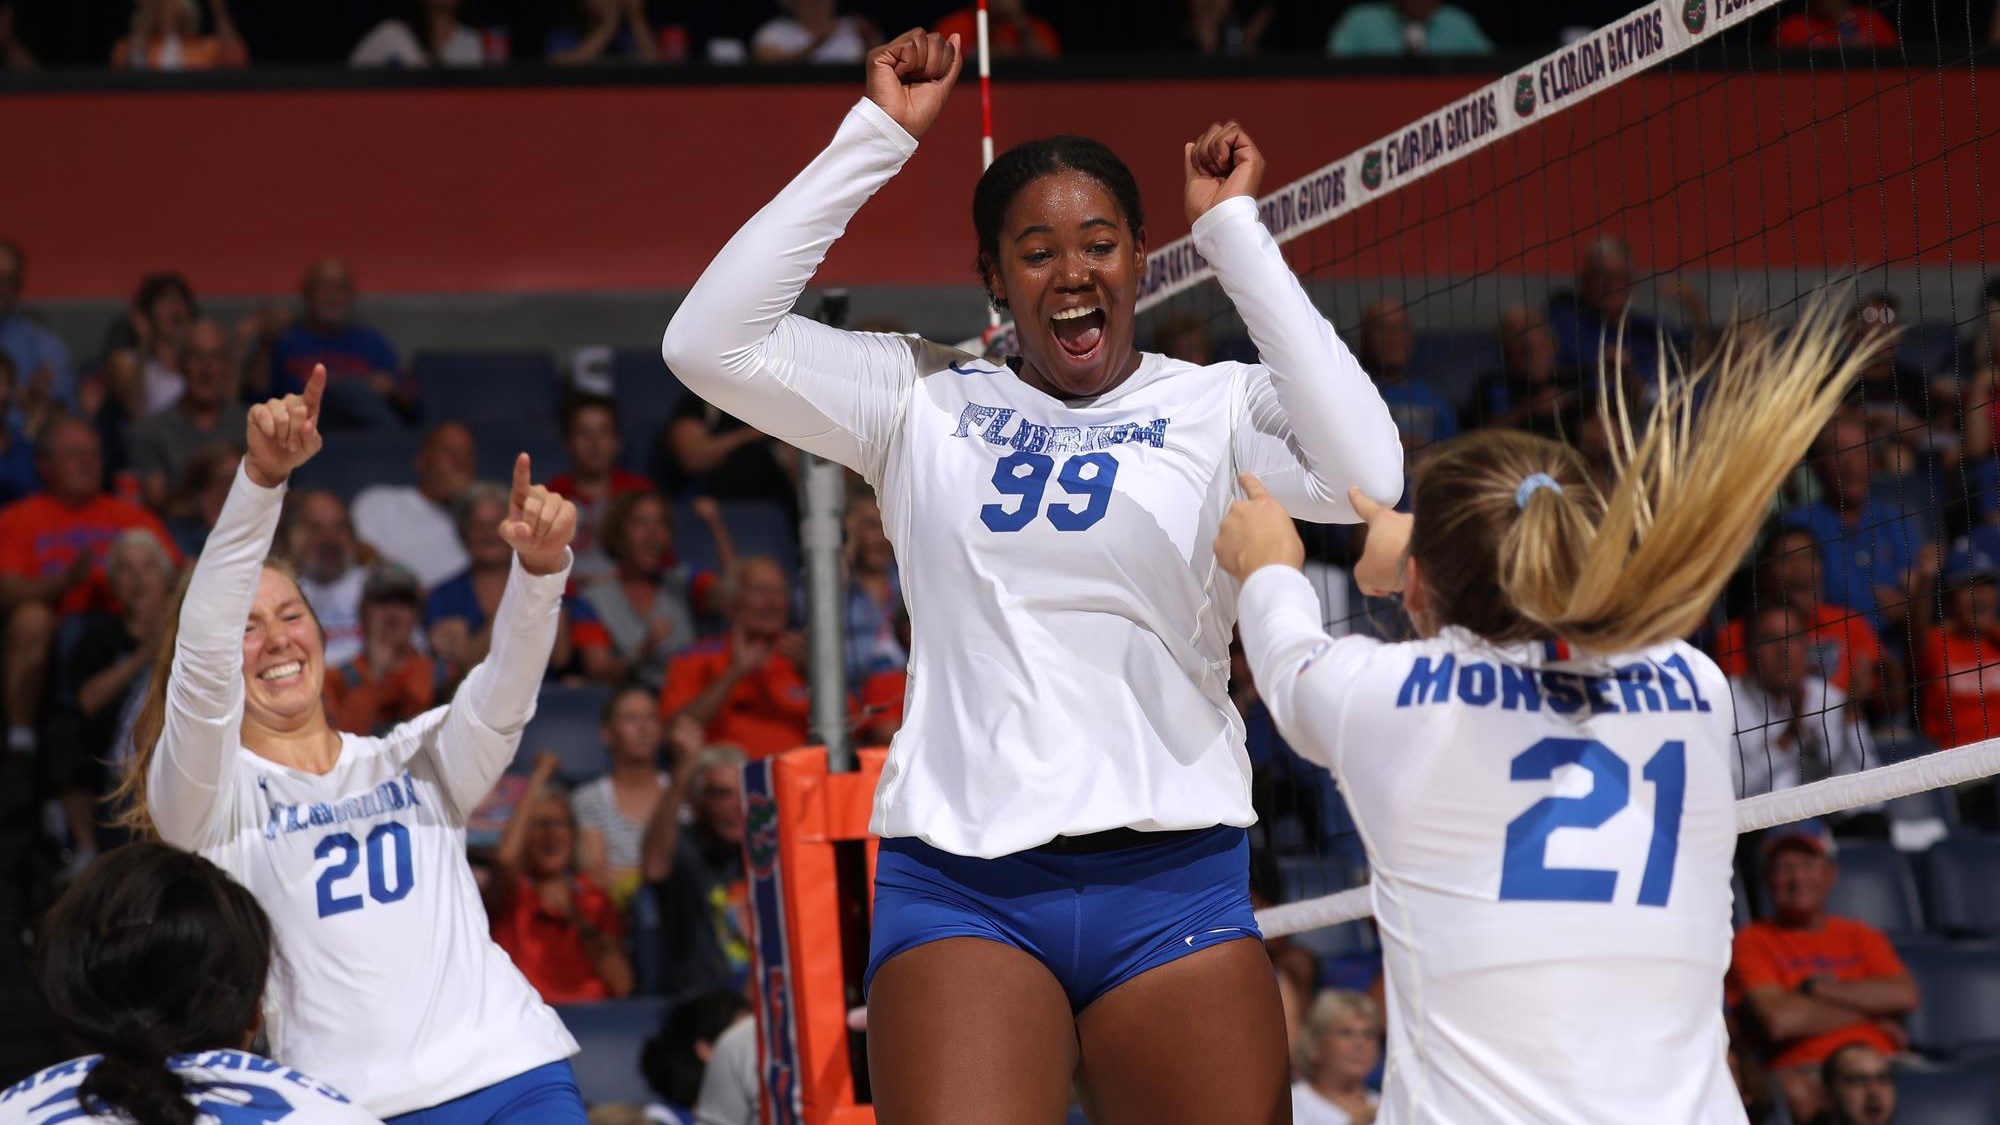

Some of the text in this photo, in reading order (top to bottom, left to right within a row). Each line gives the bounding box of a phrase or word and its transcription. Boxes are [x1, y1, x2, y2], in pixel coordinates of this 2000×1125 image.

[1539, 8, 1664, 104] FLORIDA GATORS
[1386, 117, 1444, 180] FLORDA
[950, 401, 1171, 453] FLORIDA
[979, 451, 1120, 533] 99
[1498, 736, 1687, 908] 21
[313, 821, 415, 920] 20
